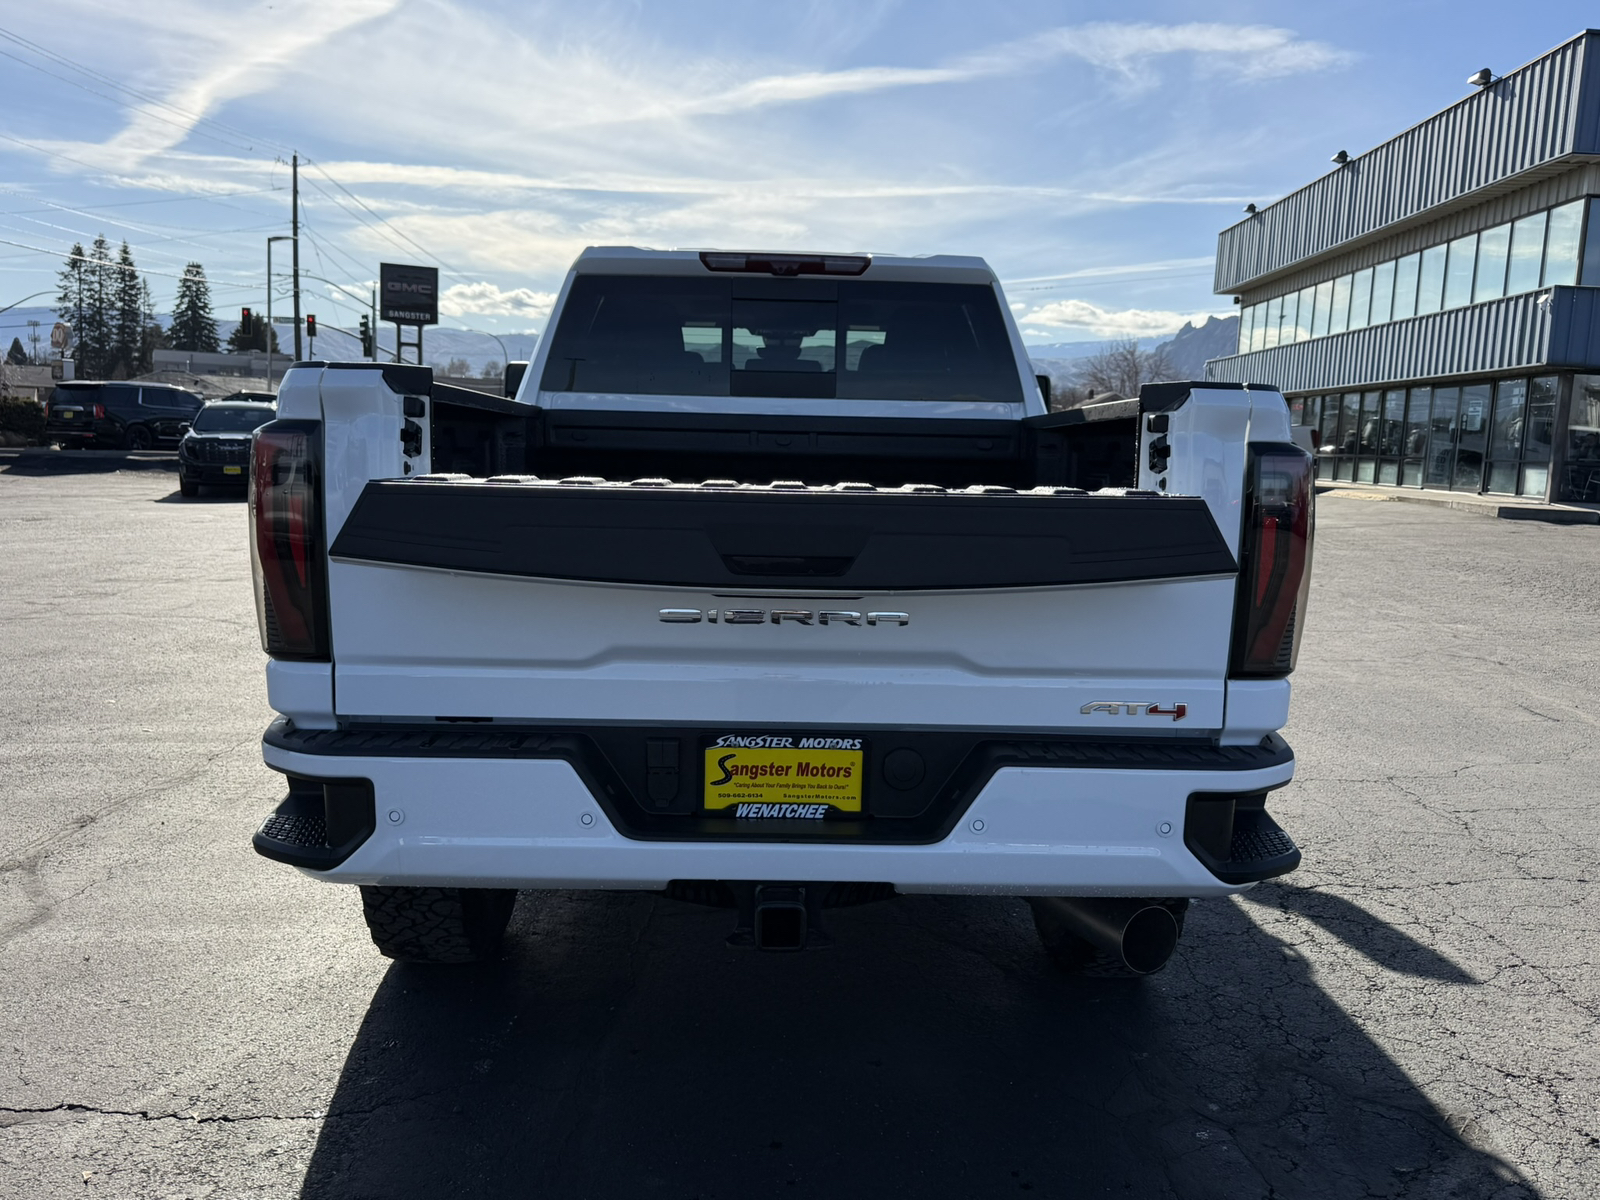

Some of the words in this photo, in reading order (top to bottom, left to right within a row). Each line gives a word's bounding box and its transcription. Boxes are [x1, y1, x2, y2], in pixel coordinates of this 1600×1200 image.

[388, 282, 431, 294] GMC
[389, 310, 431, 320] SANGSTER
[659, 608, 910, 626] SIERRA
[1080, 700, 1188, 721] AT4
[706, 734, 795, 750] SANGSTER
[799, 737, 863, 750] MOTORS
[709, 753, 793, 786] Sangster
[776, 782, 792, 790] Family
[735, 803, 828, 819] WENATCHEE
